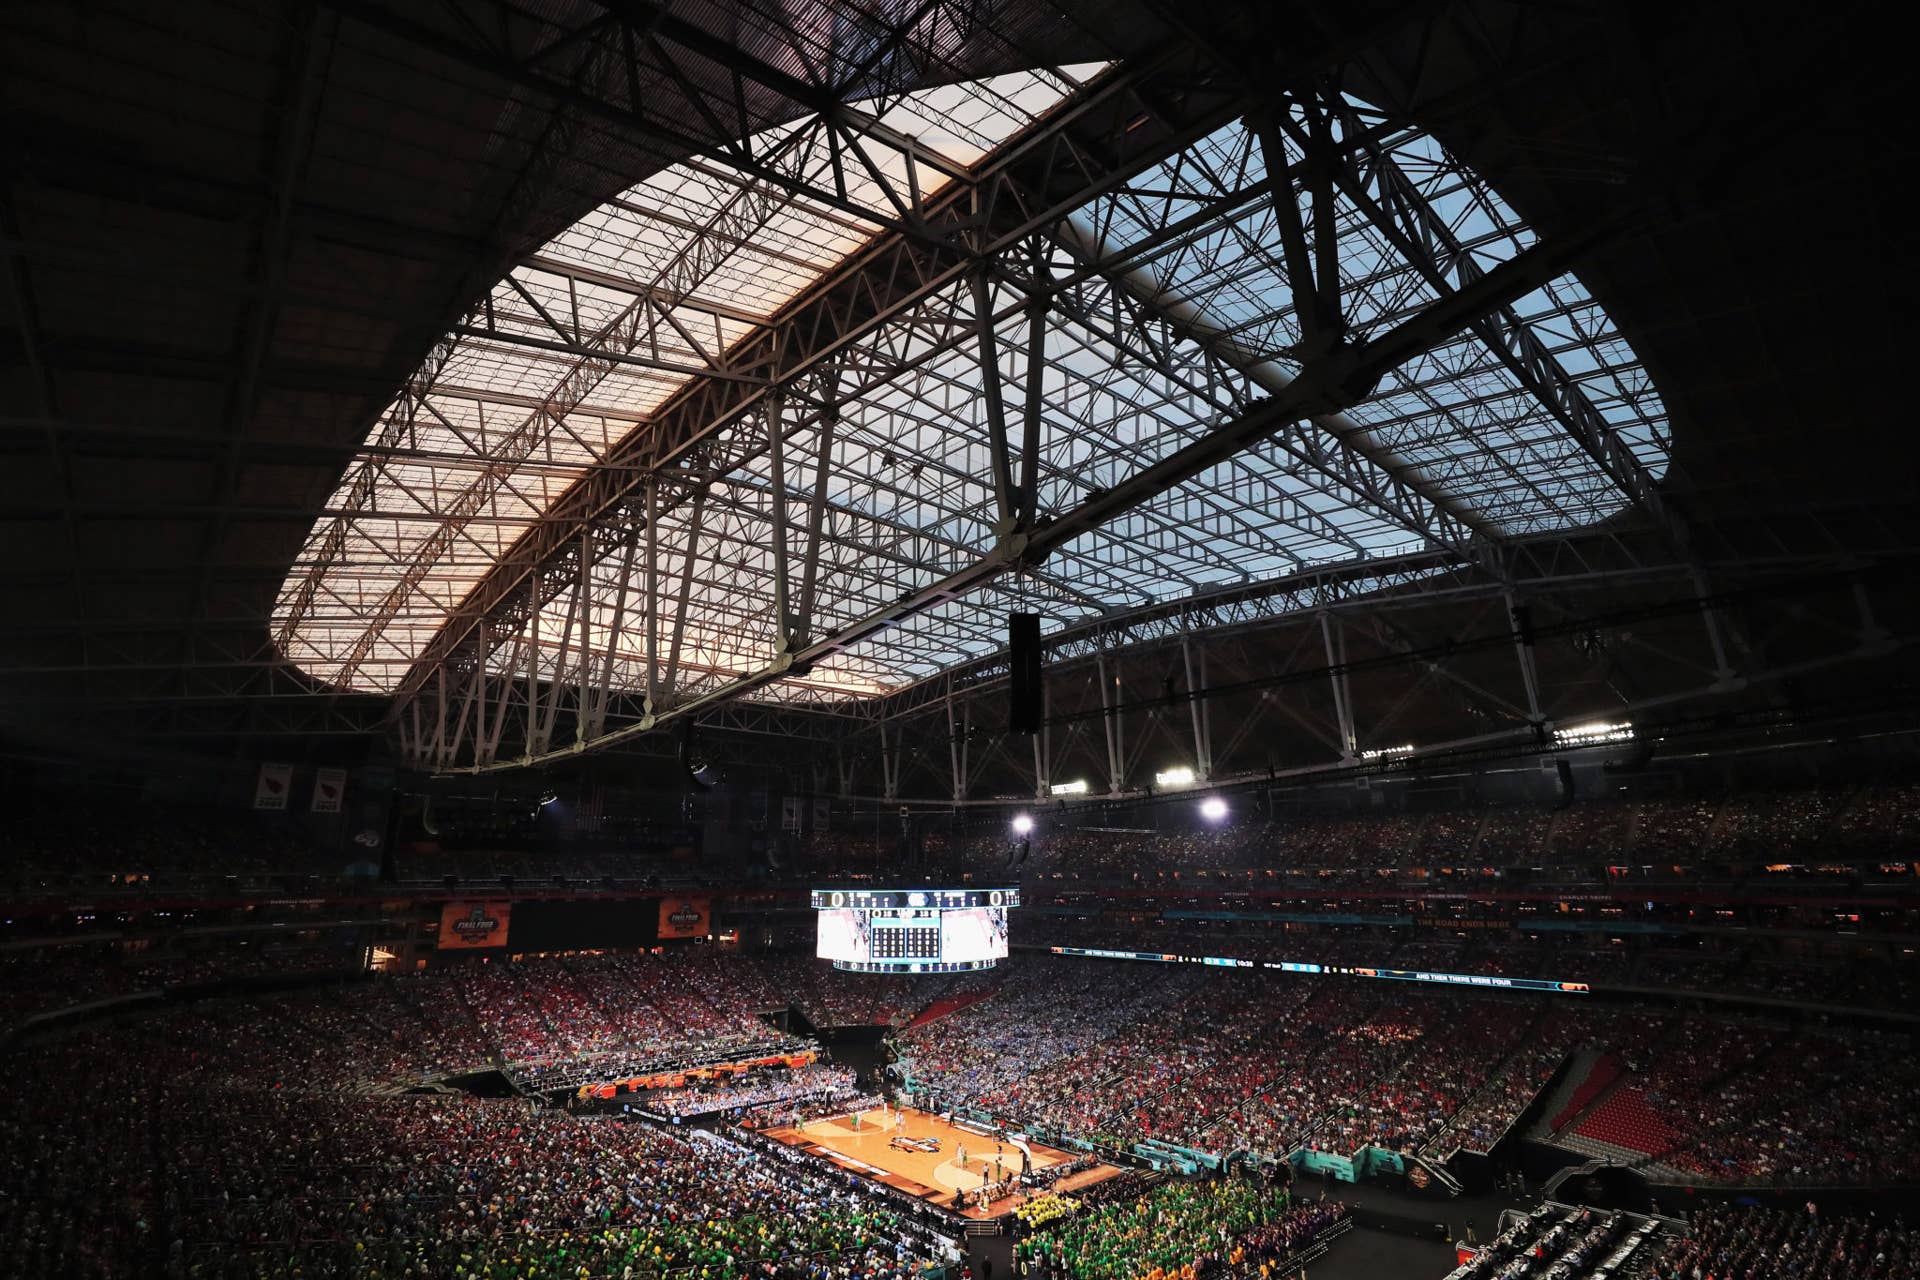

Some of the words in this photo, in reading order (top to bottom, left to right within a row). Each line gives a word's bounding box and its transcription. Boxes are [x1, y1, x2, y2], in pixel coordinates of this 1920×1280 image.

[1416, 919, 1433, 927] THE
[1434, 919, 1459, 928] ROAD
[1460, 919, 1486, 928] ENDS
[1487, 920, 1512, 929] HERE
[1448, 975, 1470, 983] THERE
[1470, 976, 1491, 984] WERE
[1492, 978, 1512, 986] FOUR
